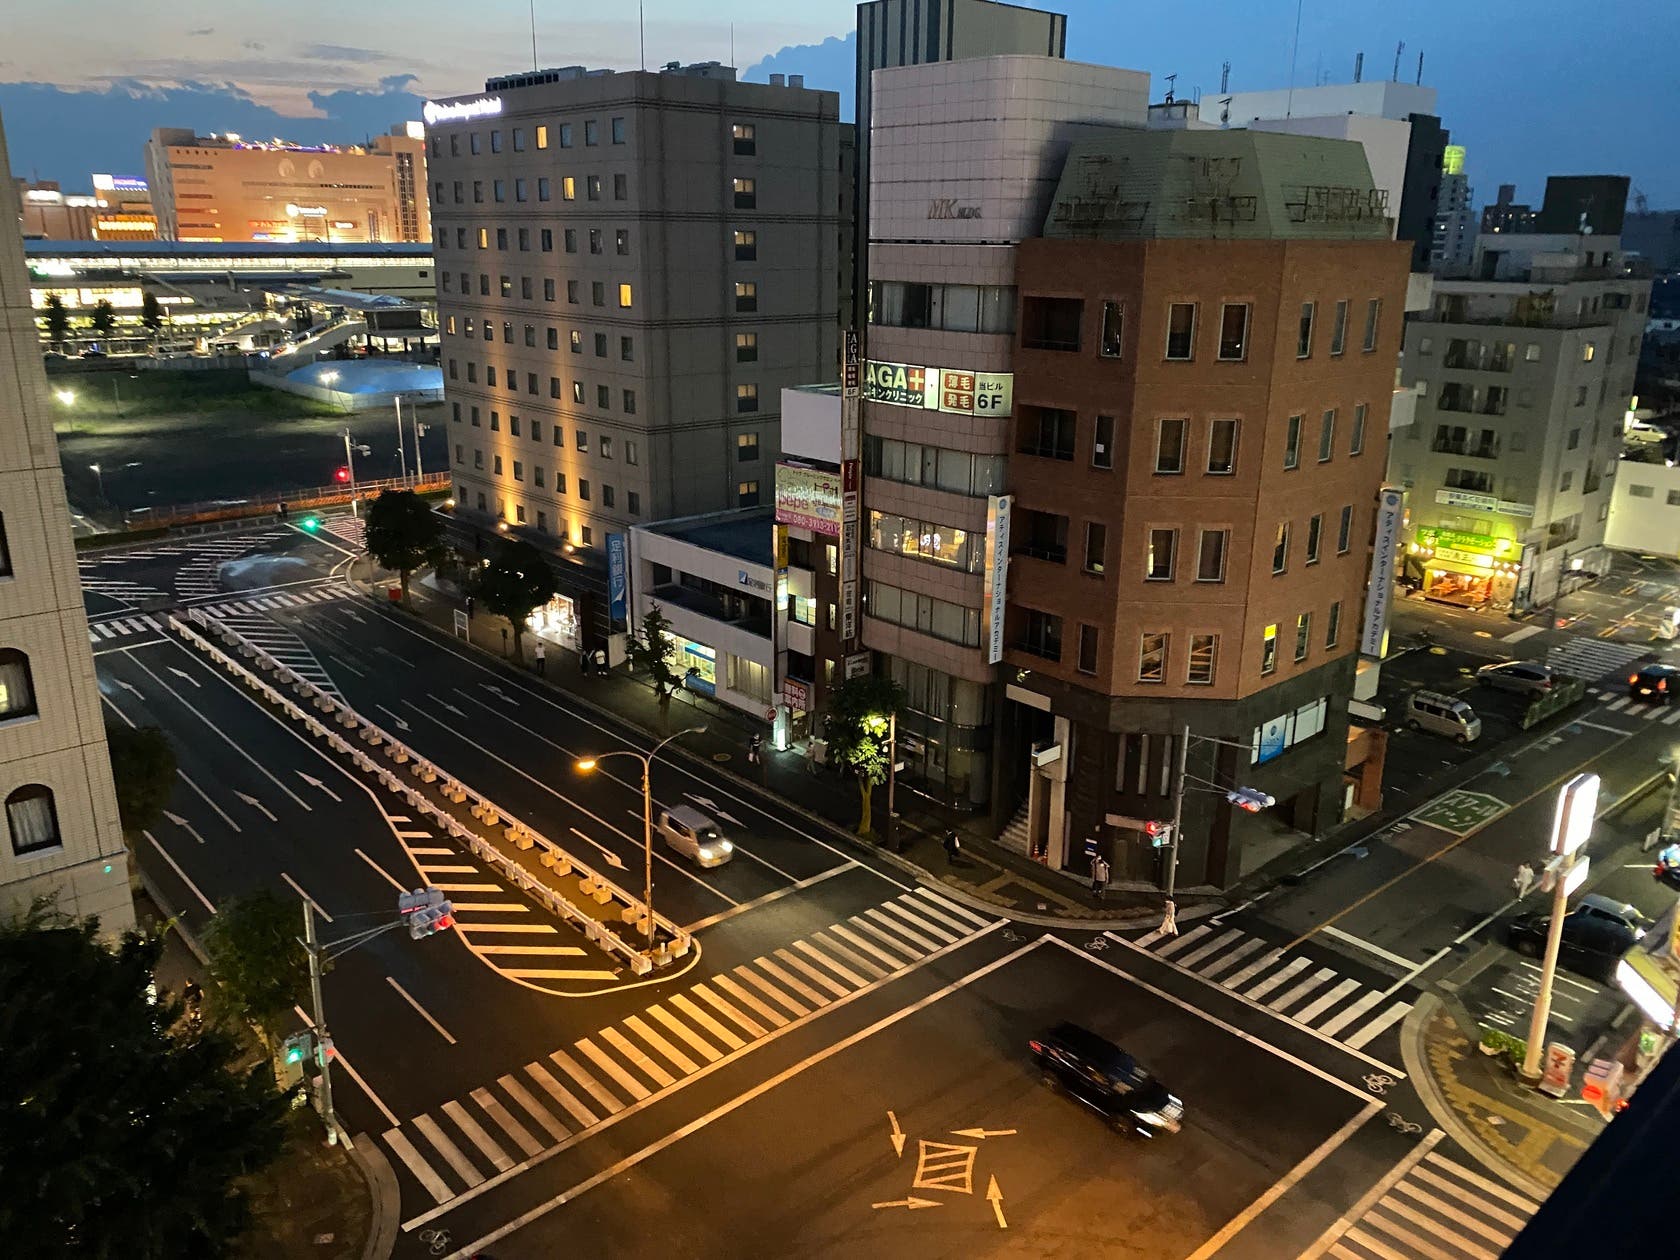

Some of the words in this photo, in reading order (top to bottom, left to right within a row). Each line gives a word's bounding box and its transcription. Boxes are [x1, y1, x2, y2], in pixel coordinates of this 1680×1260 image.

[850, 333, 858, 364] AGA
[866, 364, 908, 390] AGA
[978, 381, 1003, 392] 当ビル
[977, 394, 1003, 410] 6F
